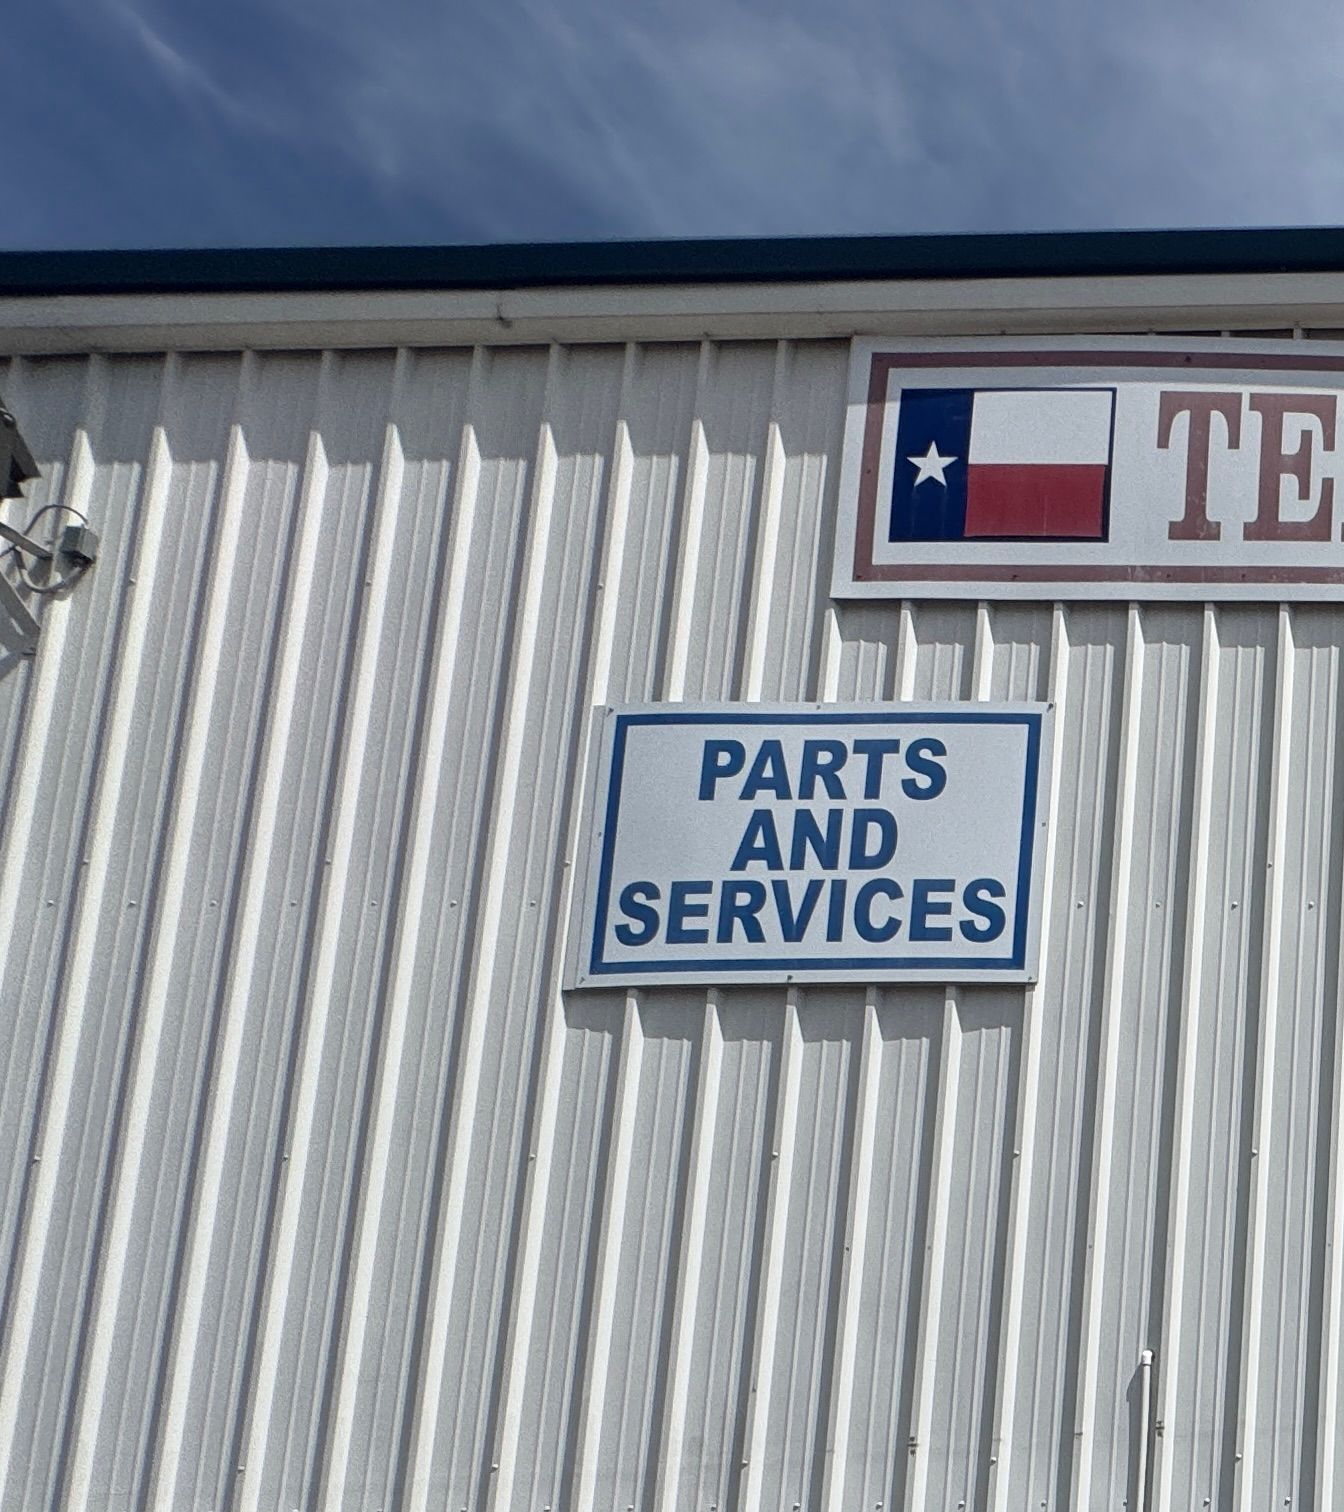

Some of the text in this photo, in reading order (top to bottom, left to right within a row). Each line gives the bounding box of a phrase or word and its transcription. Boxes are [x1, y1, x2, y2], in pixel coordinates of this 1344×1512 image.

[698, 737, 948, 802] PARTS
[730, 808, 898, 872] AND
[614, 877, 1006, 947] SERVICES
